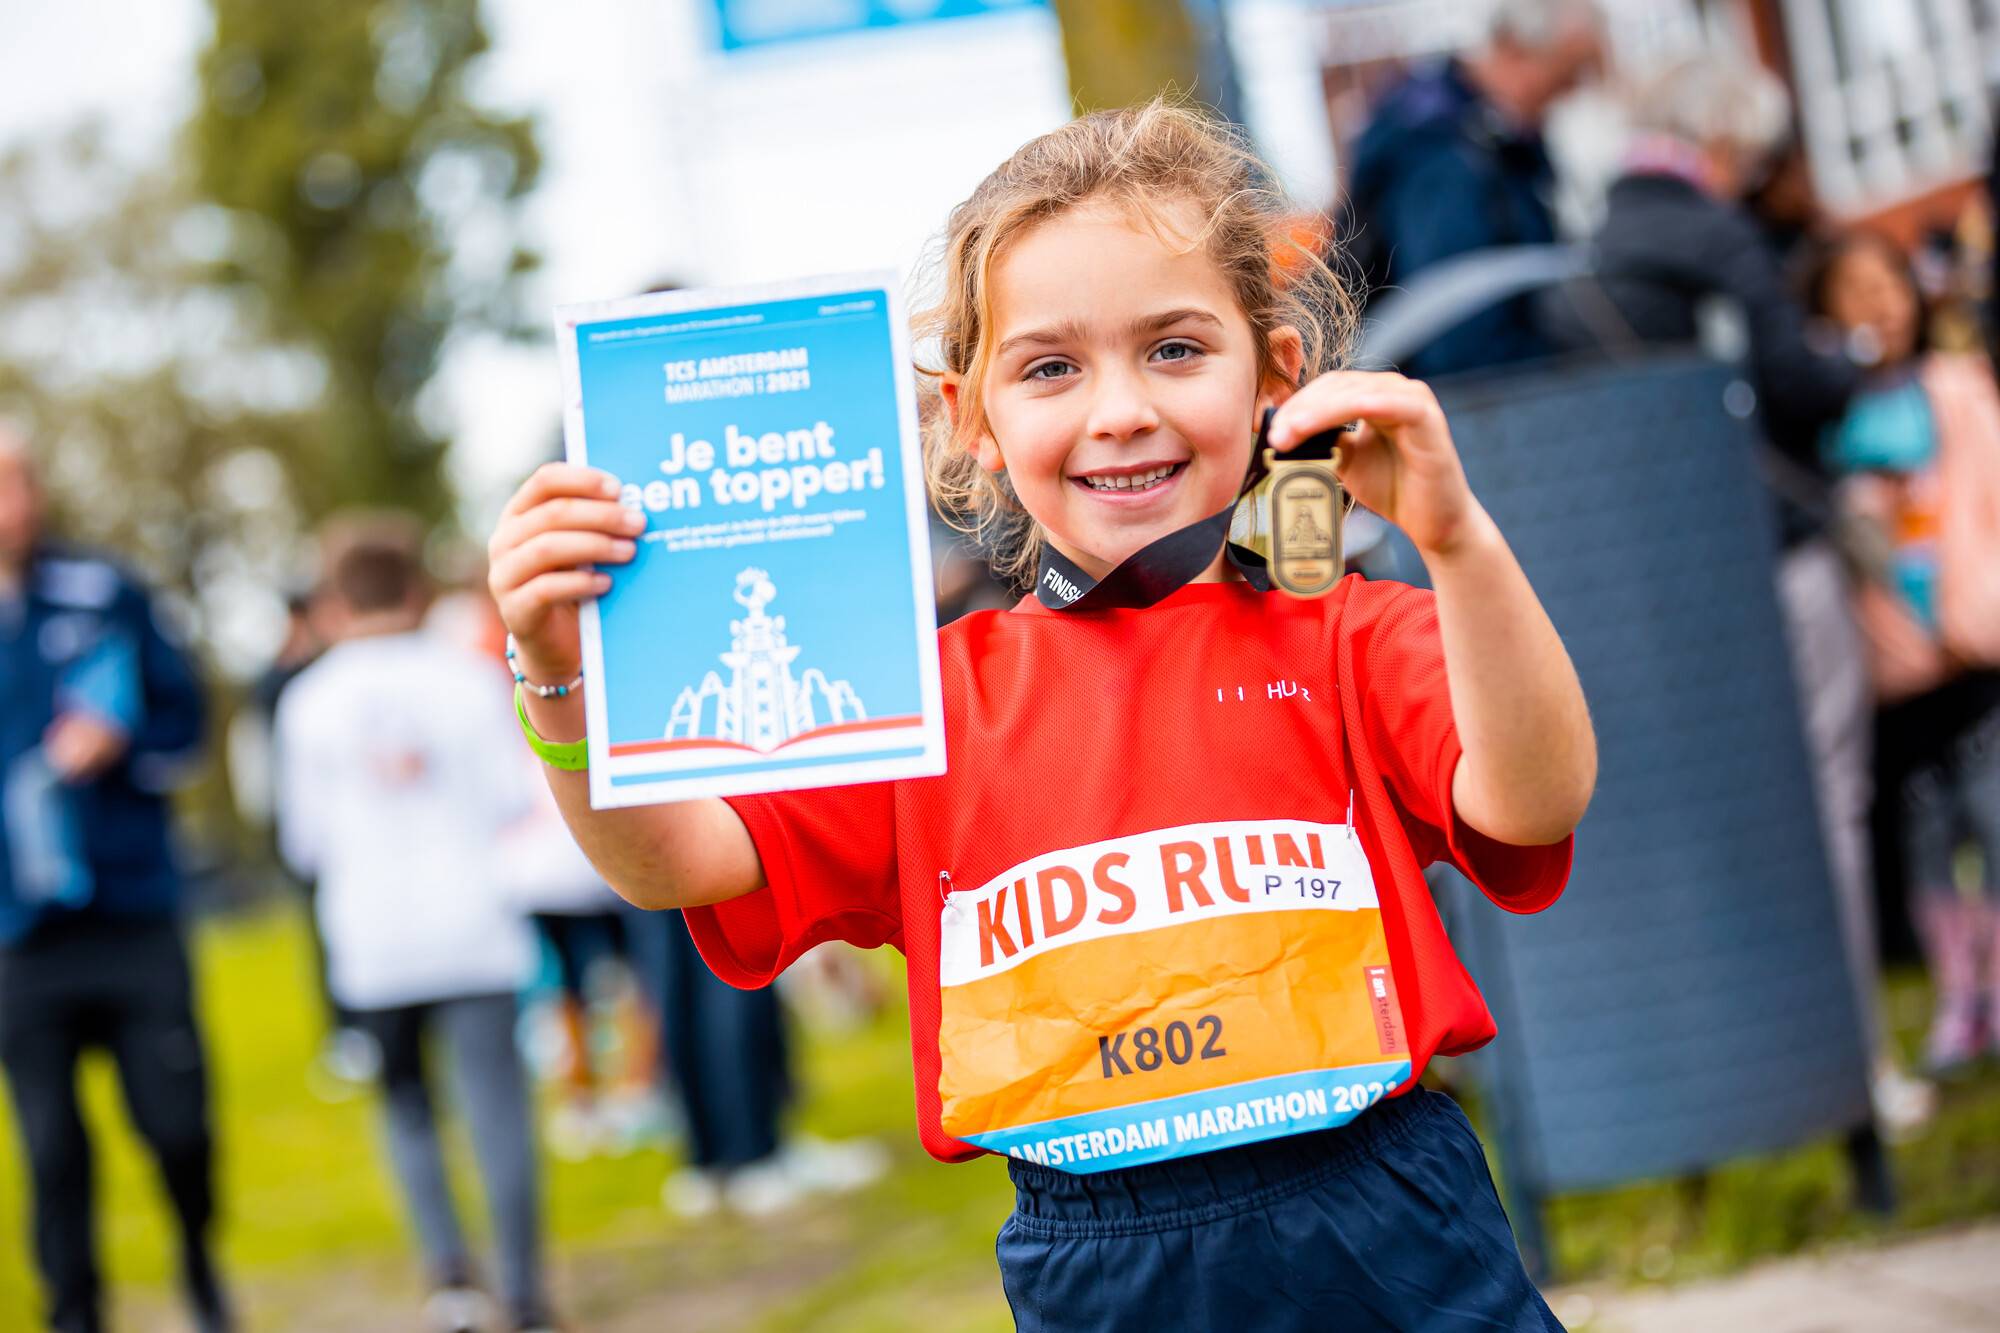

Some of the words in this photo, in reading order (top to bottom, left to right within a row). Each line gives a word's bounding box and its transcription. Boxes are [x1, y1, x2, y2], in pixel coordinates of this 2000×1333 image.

[664, 360, 697, 382] TCS
[699, 347, 809, 379] AMSTERDAM
[664, 375, 754, 404] MARATHON
[766, 369, 811, 394] 2021
[660, 433, 714, 474] Je
[725, 421, 835, 467] bent
[710, 448, 885, 511] topper!
[976, 852, 1137, 968] KIDS
[1264, 874, 1282, 895] P
[1294, 876, 1342, 900] 197
[1098, 1014, 1228, 1080] K802
[1173, 1090, 1327, 1143] MARATHON
[1331, 1081, 1397, 1113] 202
